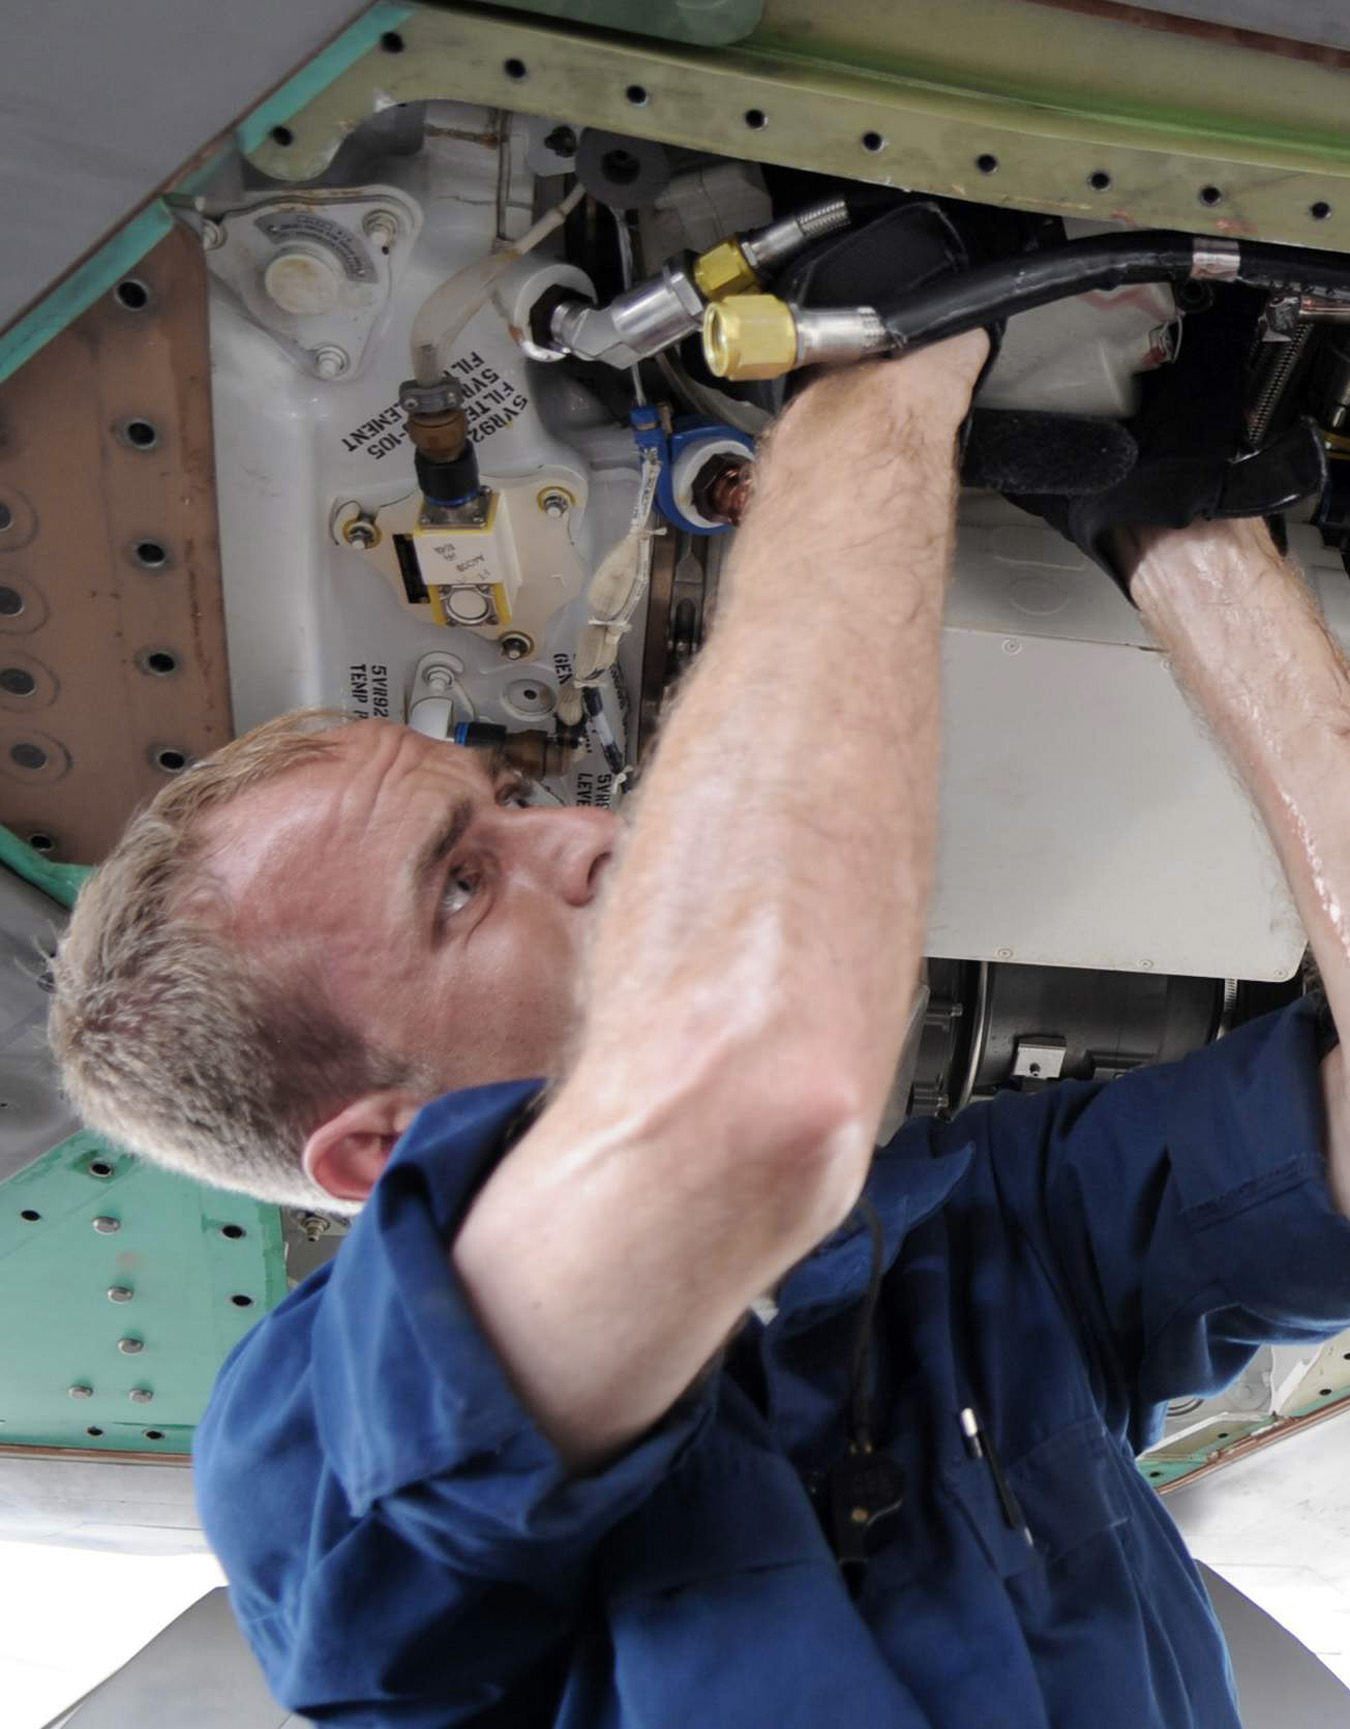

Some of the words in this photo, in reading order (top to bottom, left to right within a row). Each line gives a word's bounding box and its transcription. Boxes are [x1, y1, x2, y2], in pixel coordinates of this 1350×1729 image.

[464, 381, 515, 423] FILTE
[466, 394, 528, 443] 5VR92
[342, 402, 403, 452] EMENT
[366, 423, 407, 460] -105
[350, 664, 368, 703] TEMP
